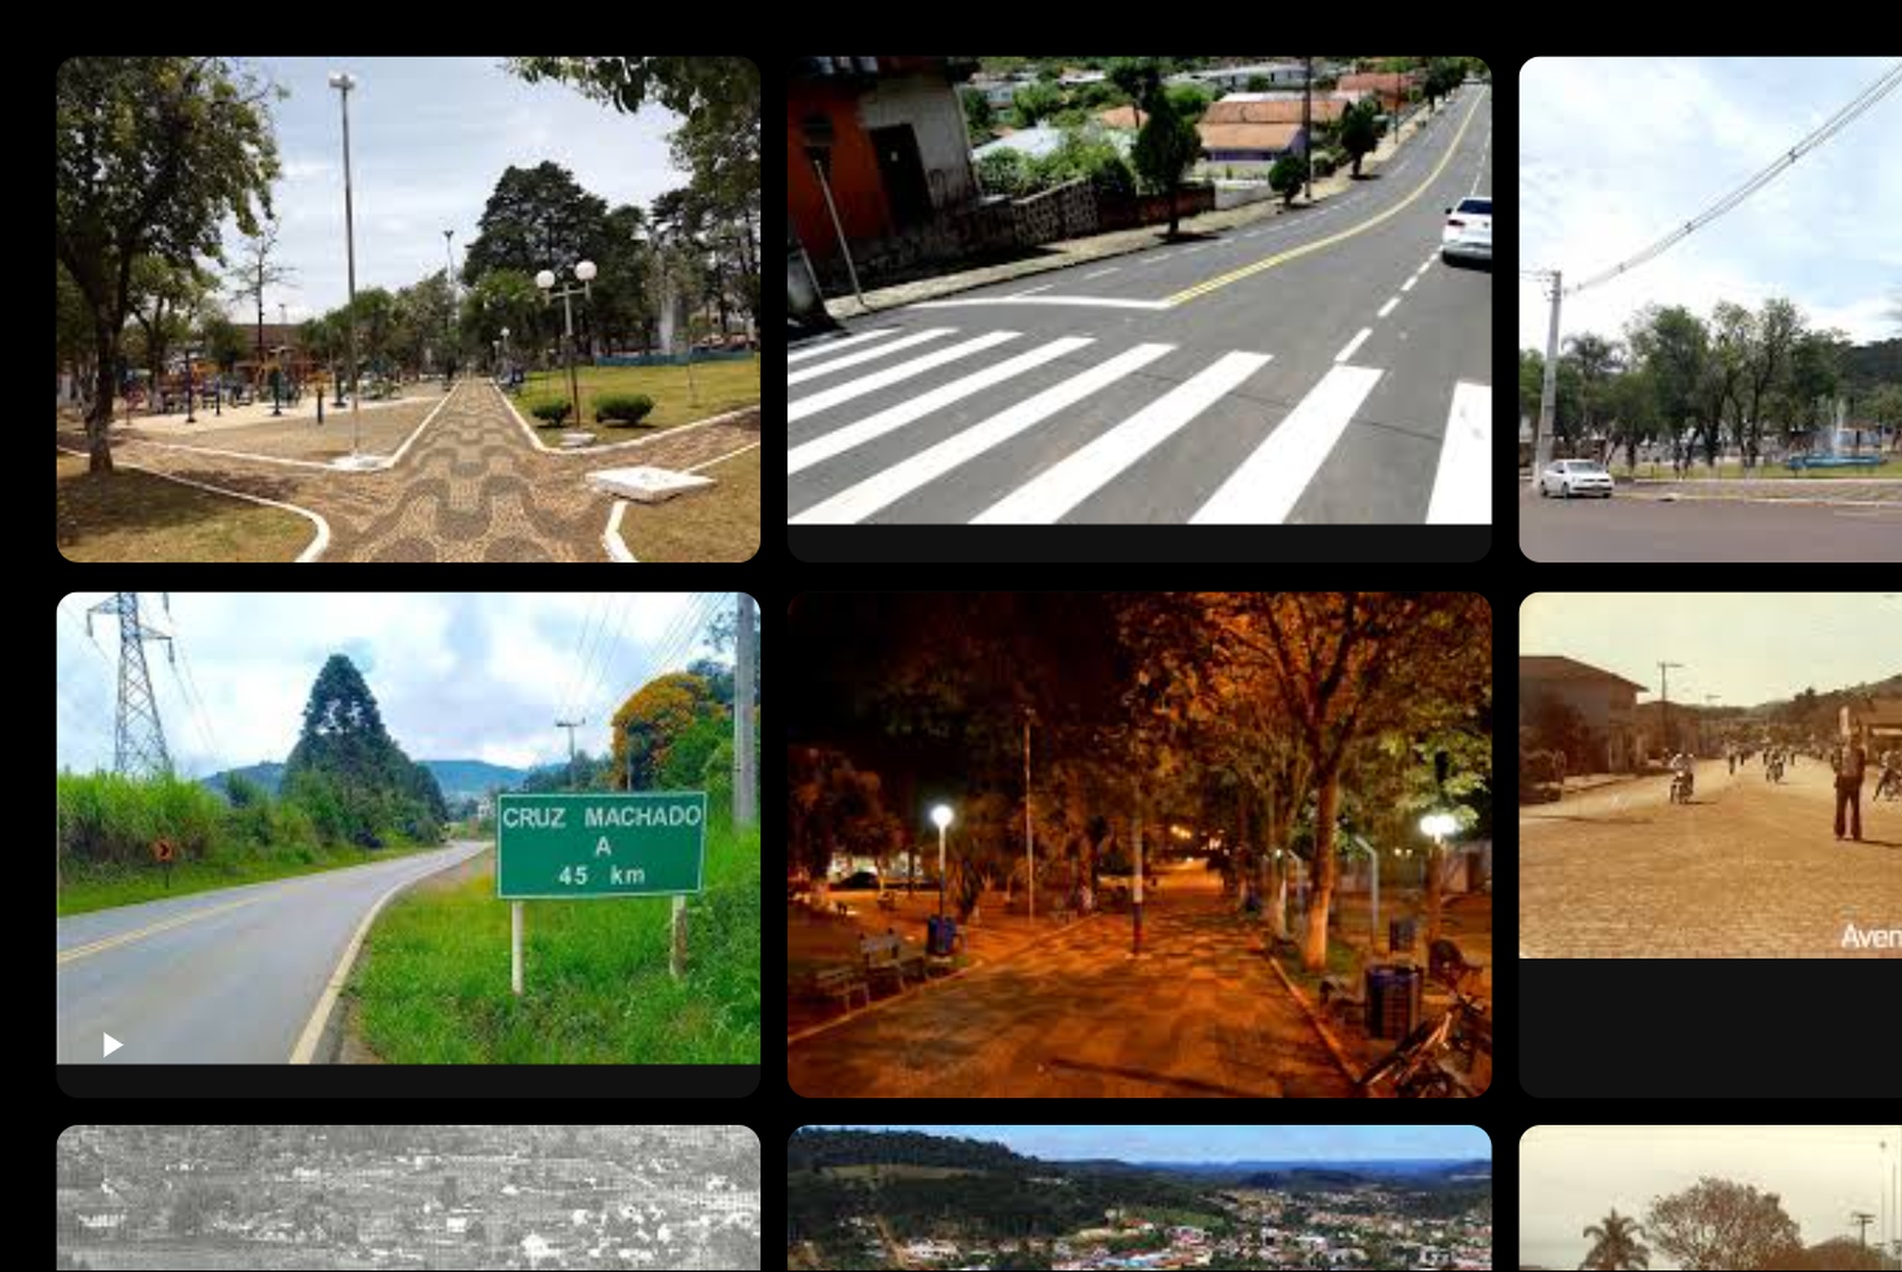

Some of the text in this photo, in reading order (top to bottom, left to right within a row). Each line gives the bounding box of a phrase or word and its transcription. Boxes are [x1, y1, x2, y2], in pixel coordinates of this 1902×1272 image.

[502, 805, 701, 828] CRUZ MACHADO
[595, 836, 611, 855] A
[558, 865, 645, 885] 45 km
